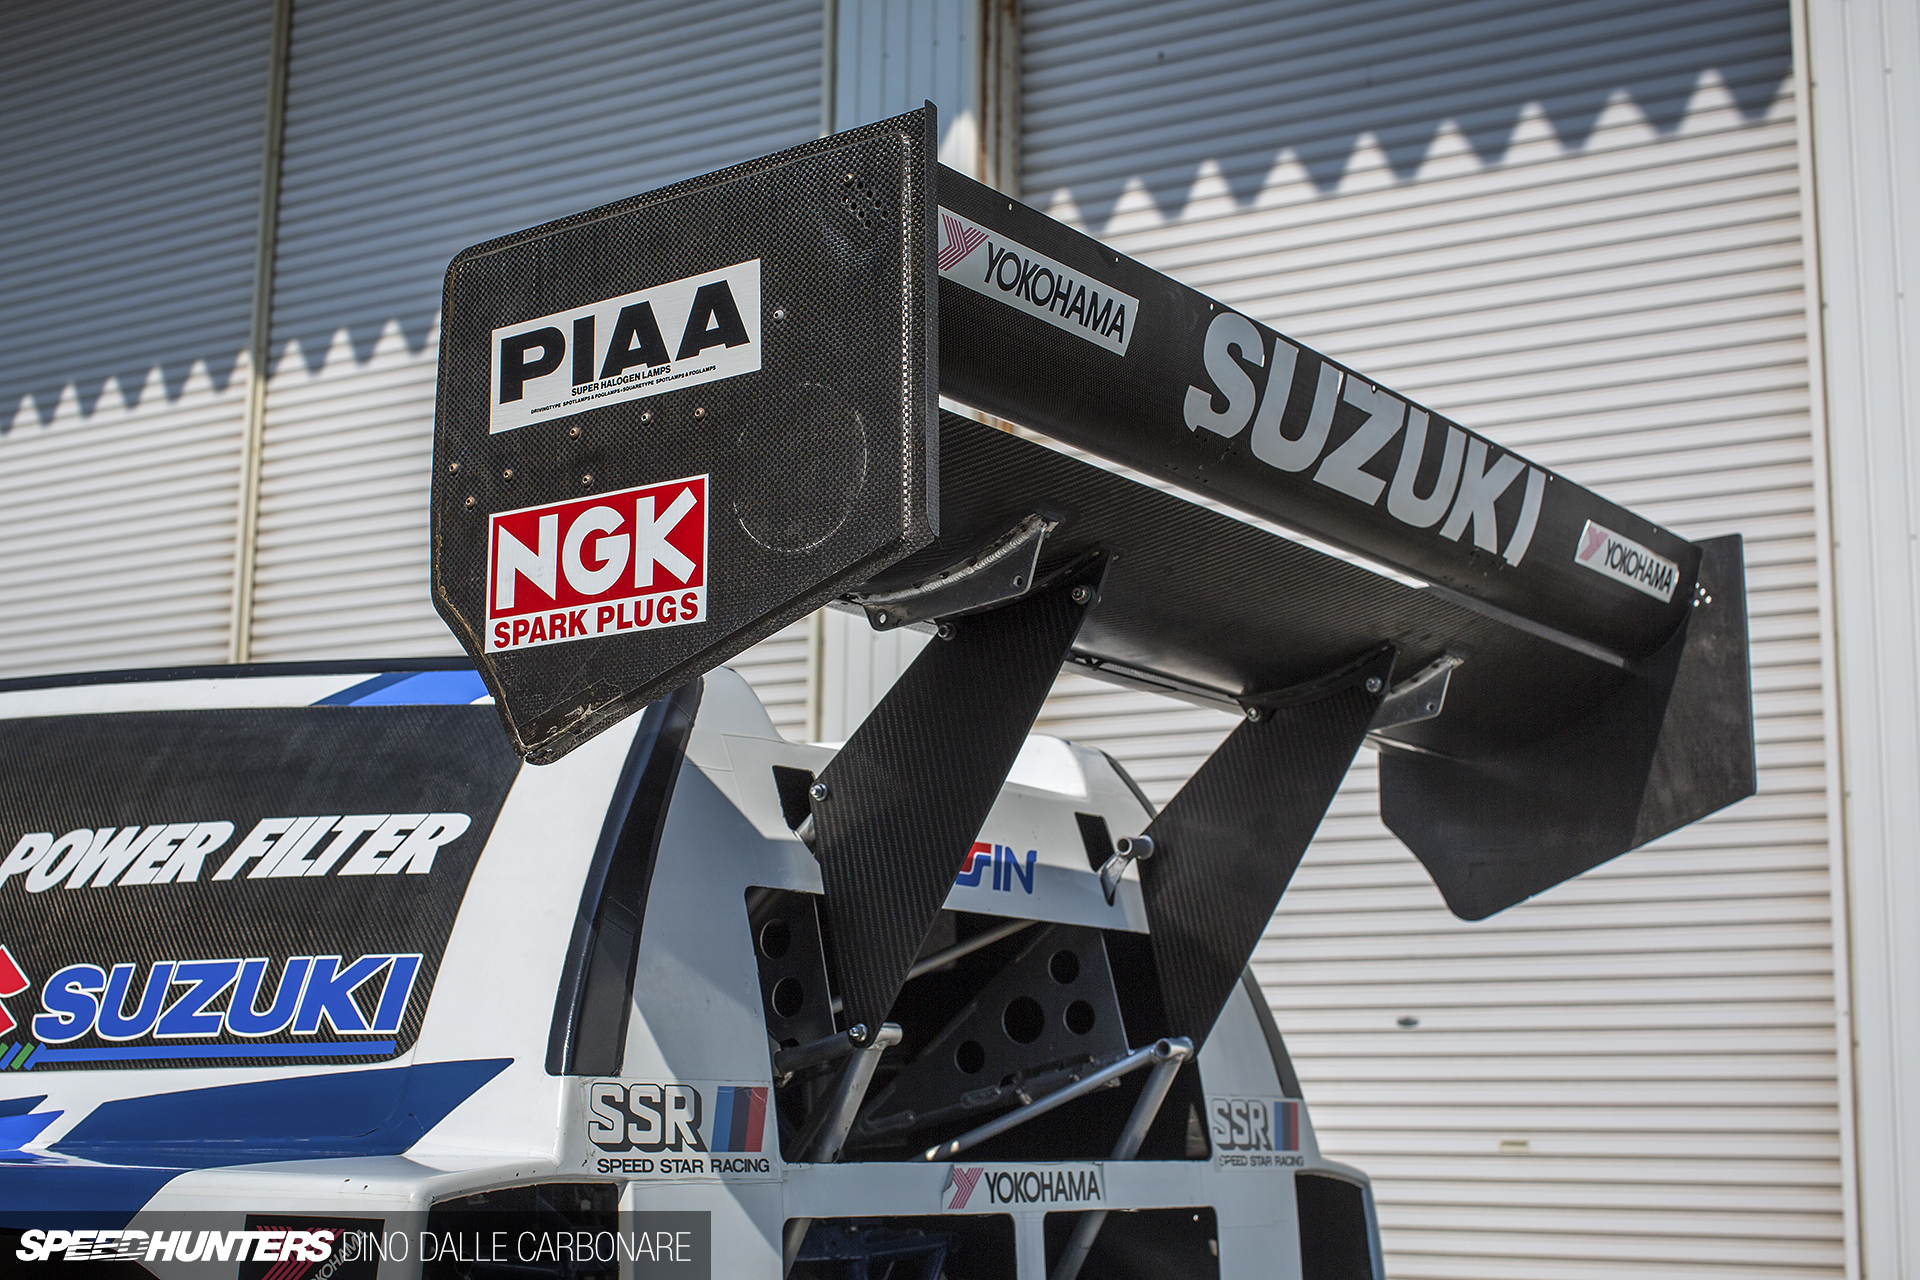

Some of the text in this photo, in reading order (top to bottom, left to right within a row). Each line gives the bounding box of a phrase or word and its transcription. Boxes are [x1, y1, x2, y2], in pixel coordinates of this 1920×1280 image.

[984, 241, 1125, 344] YOKOHAMA
[499, 279, 751, 405] PIAA
[530, 403, 561, 414] DRIVINGTYPE
[562, 395, 591, 407] SPOTLAMPS
[656, 374, 685, 385] SPOTLAMPS
[689, 365, 717, 376] FOGLAMPS
[571, 365, 671, 396] SUPER HALOGEN LAMPS
[1183, 312, 1547, 568] SUZUKI
[496, 486, 698, 611] NGK
[1604, 538, 1673, 594] YOKOHAMA
[493, 592, 699, 649] SPARK PLUGS
[0, 813, 472, 893] POWER FILTER
[32, 953, 424, 1044] SUZUKI
[588, 1082, 709, 1153] SSR
[1211, 1097, 1273, 1151] SSR
[597, 1158, 770, 1174] SPEED STAR RACING
[984, 1171, 1101, 1204] YOKOHAMA
[1218, 1154, 1304, 1166] SPEED STAR RACING
[311, 1229, 369, 1280] KOHAMA
